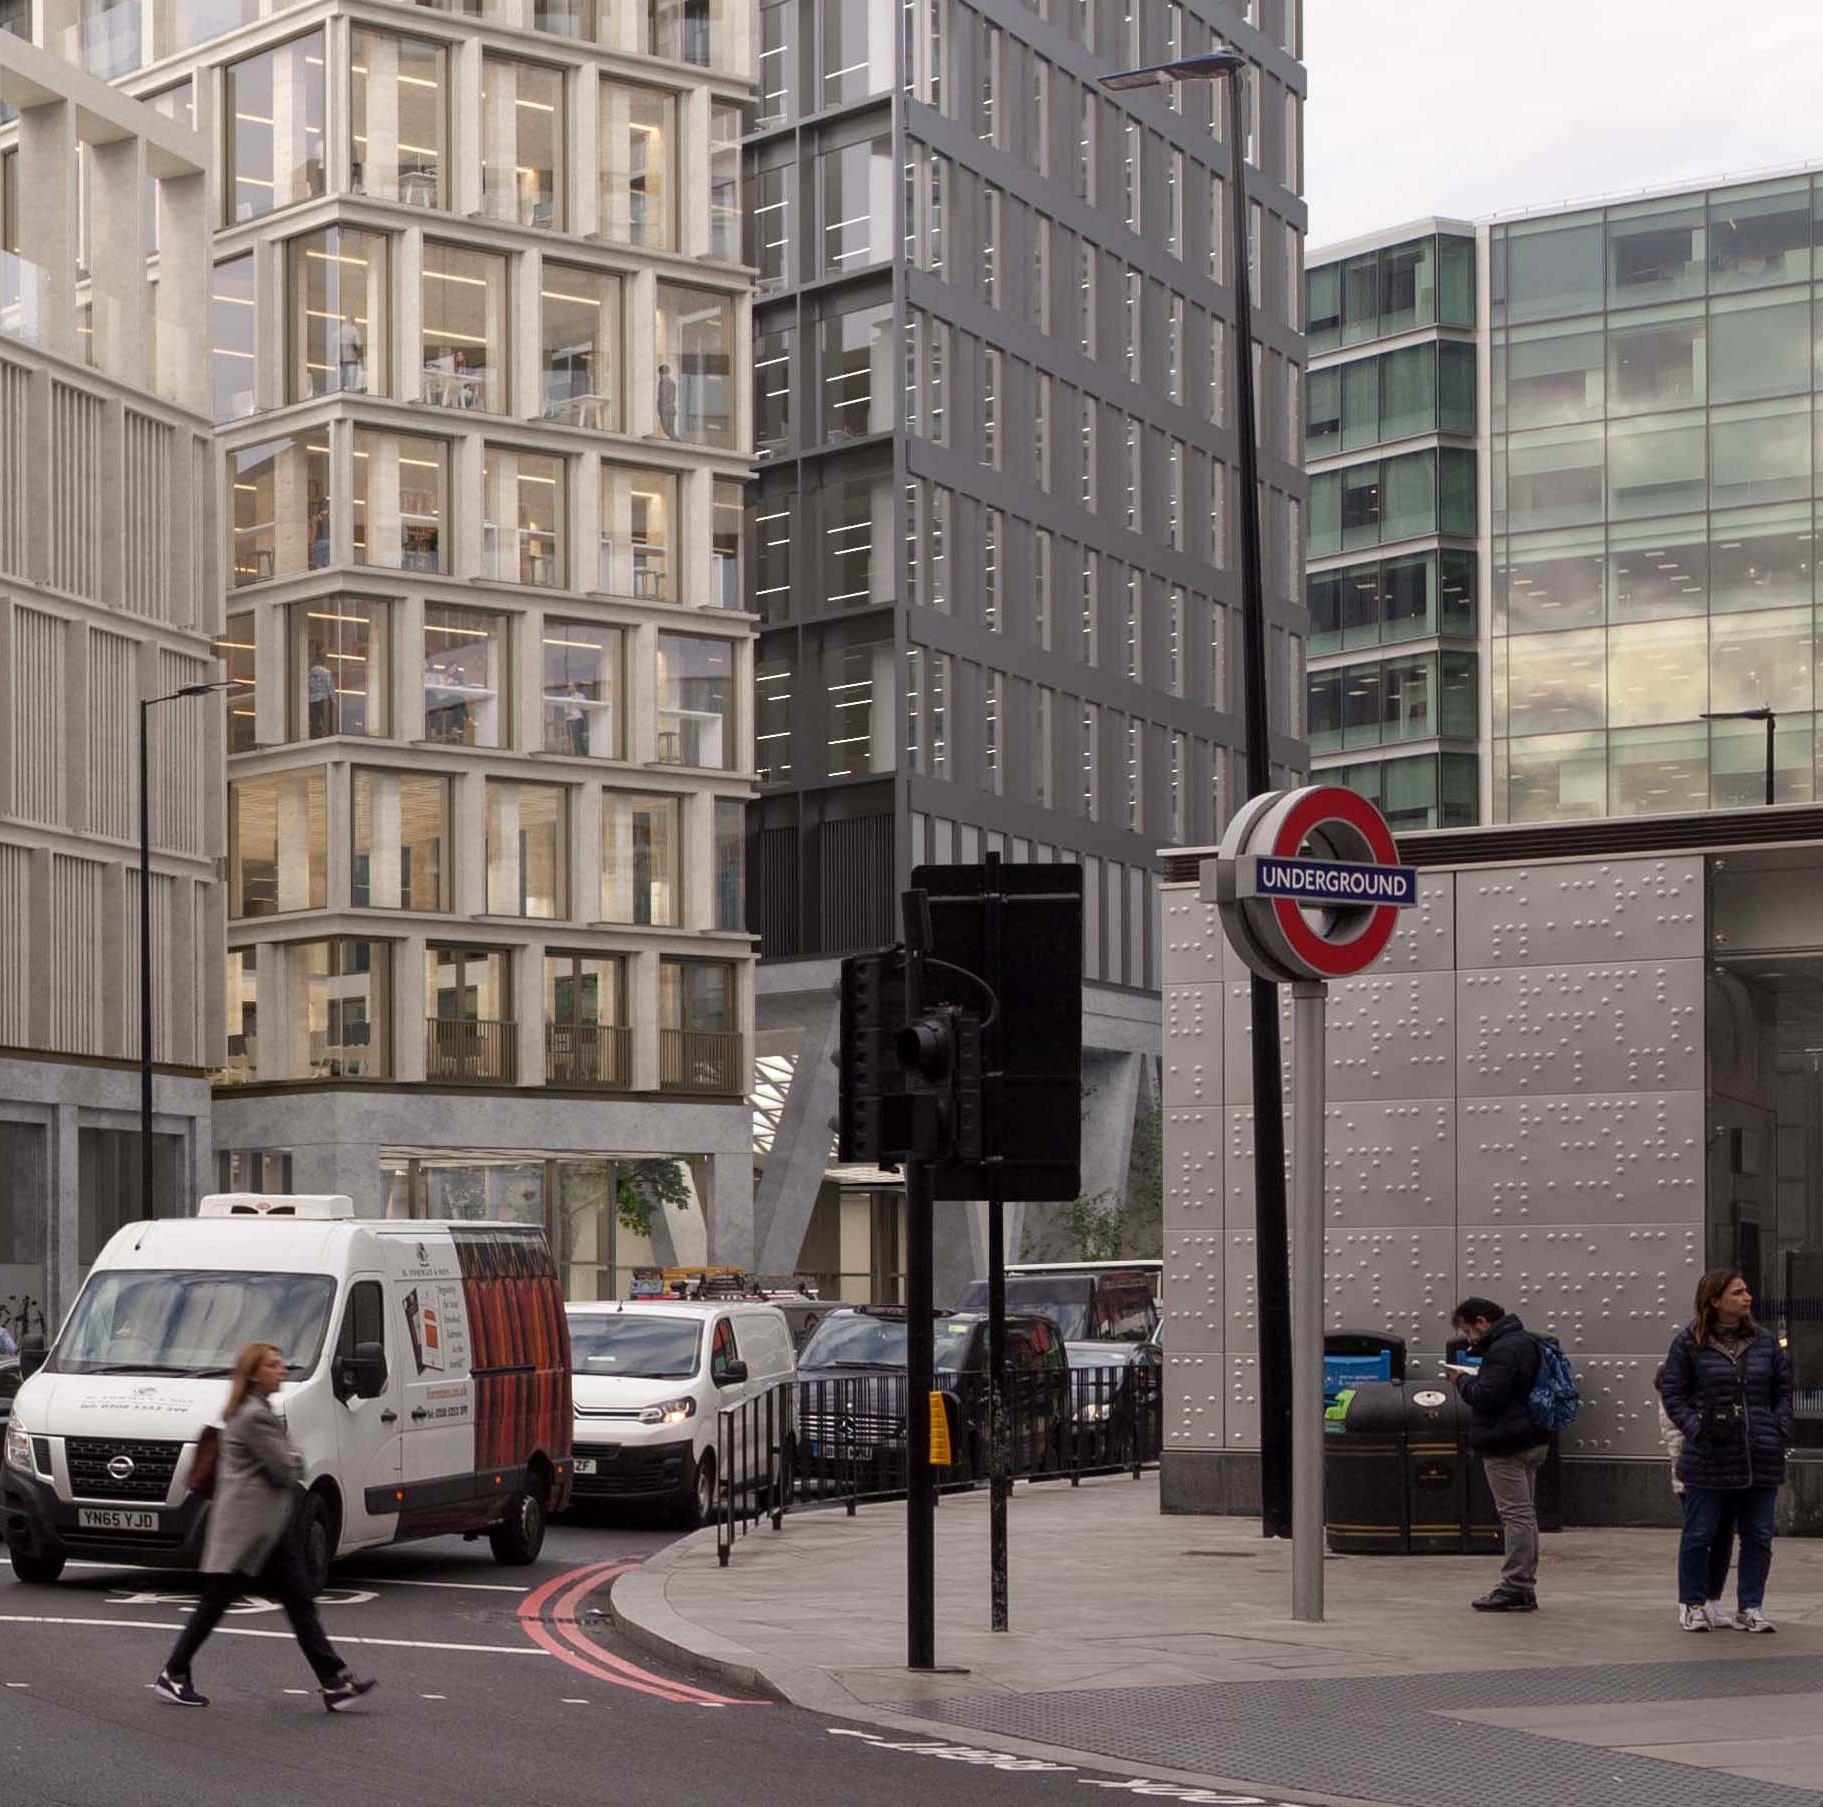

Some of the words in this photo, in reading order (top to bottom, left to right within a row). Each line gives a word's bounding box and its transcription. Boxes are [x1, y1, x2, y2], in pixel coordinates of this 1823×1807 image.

[1262, 866, 1407, 897] UNDERGROUND
[575, 1460, 590, 1472] ZF
[84, 1510, 121, 1526] YN65
[124, 1513, 153, 1528] YJD
[863, 1740, 1078, 1771] RIGHT
[1078, 1779, 1308, 1807] OOK
